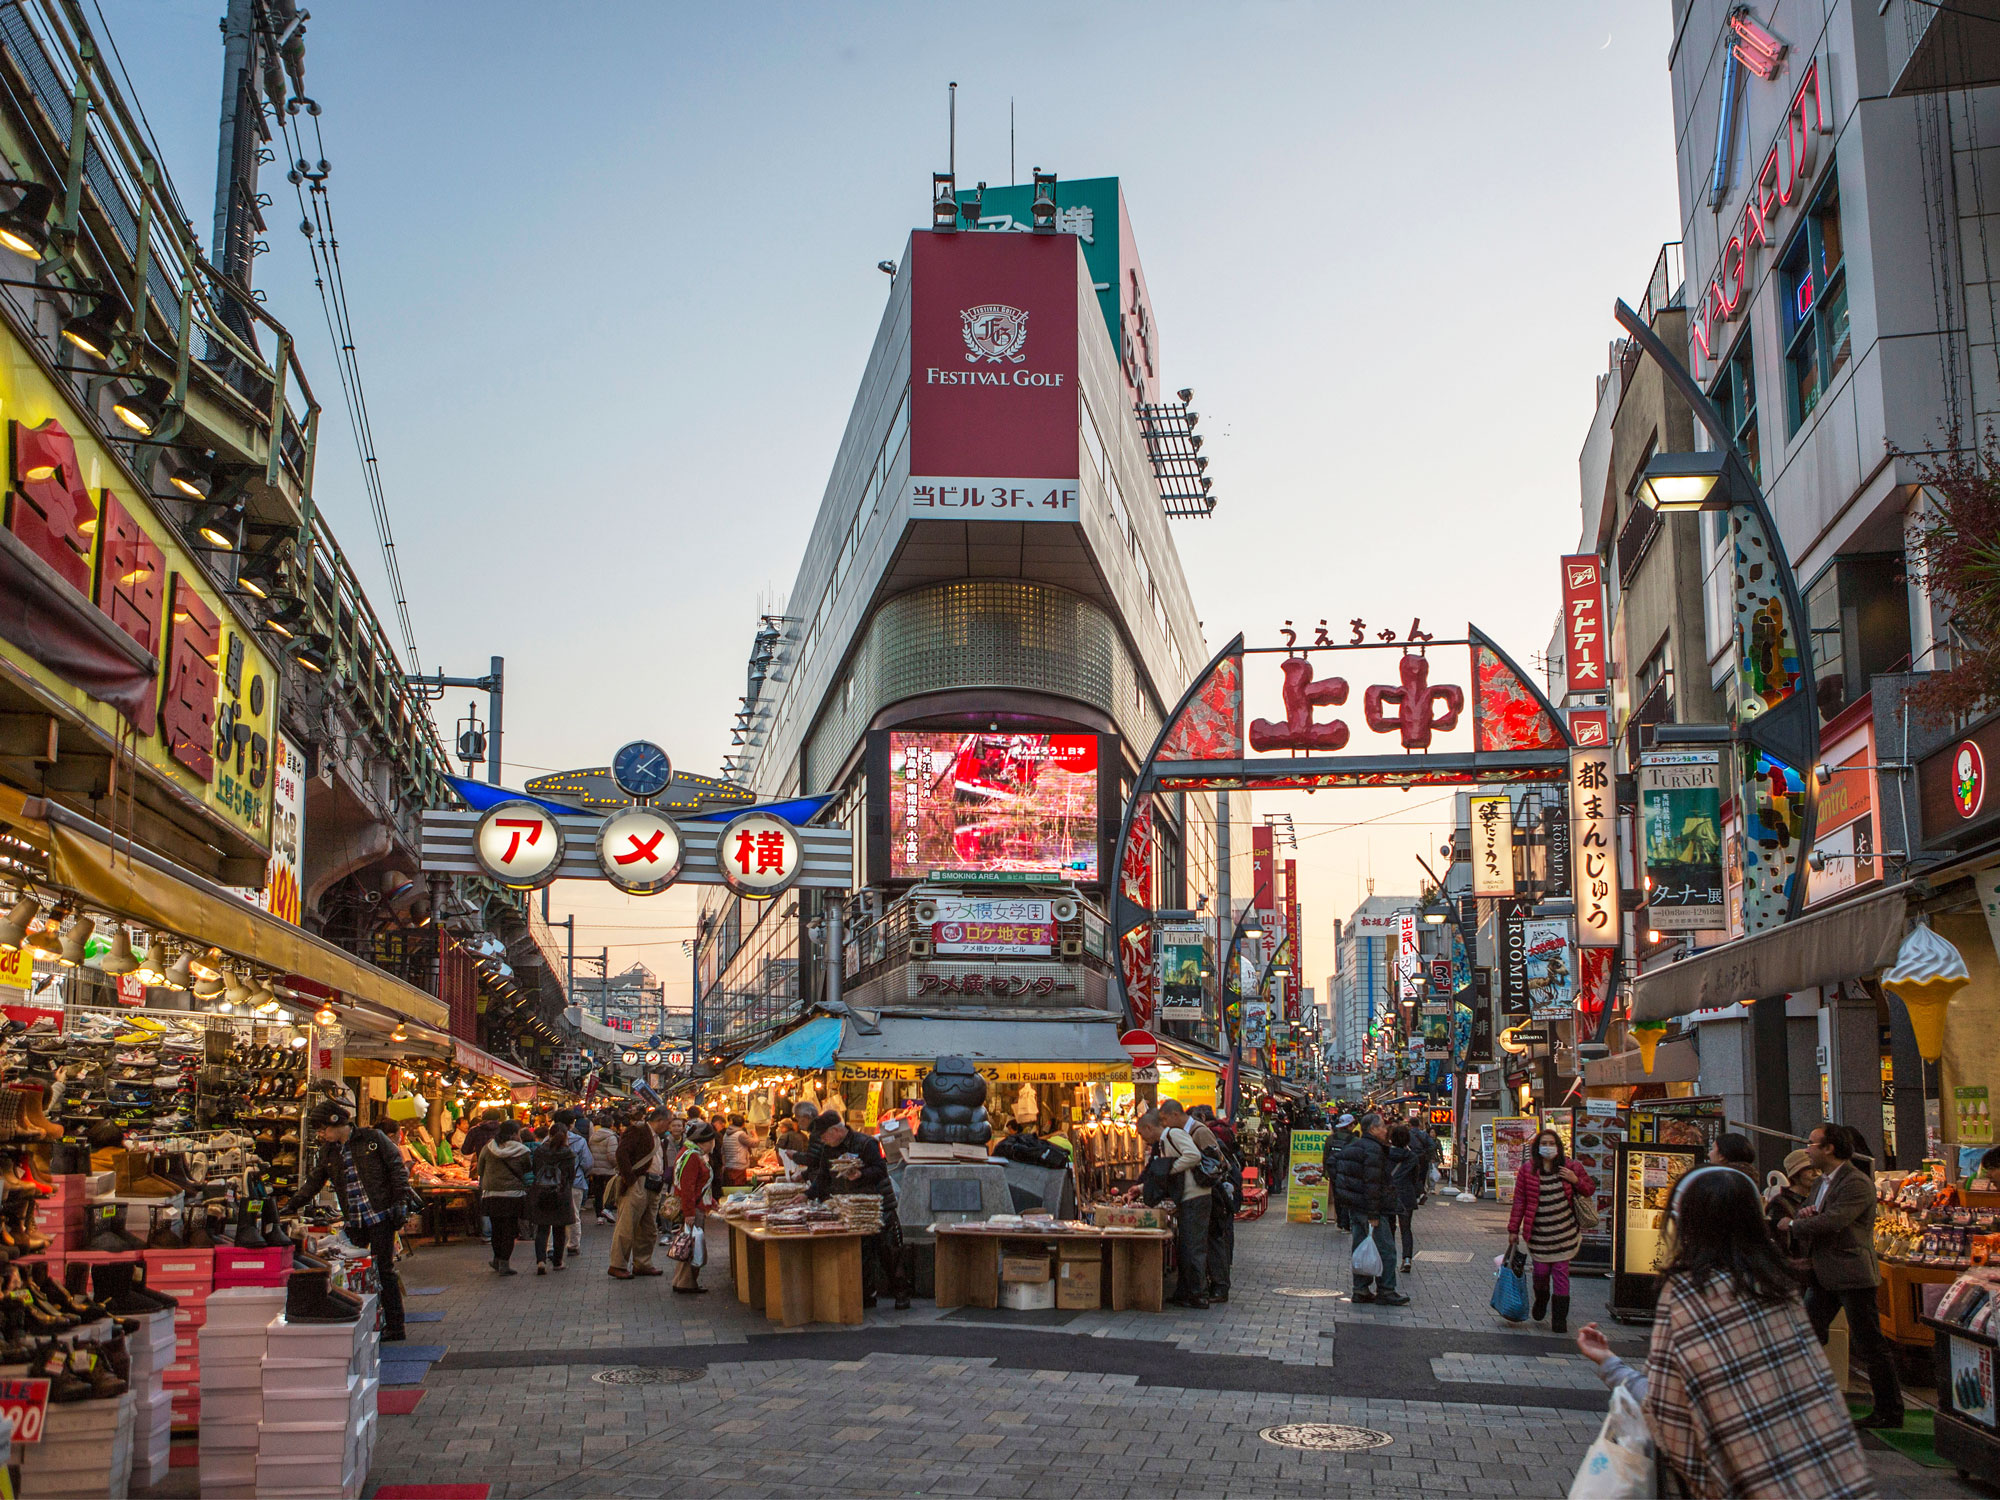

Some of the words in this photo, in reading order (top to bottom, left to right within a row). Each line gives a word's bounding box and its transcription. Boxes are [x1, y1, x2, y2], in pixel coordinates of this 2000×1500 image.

[926, 367, 1010, 387] FESTIVAL
[1013, 369, 1064, 387] GOLF
[1280, 617, 1433, 648] うえちゅん
[1572, 599, 1599, 679] アドアーズ
[1249, 654, 1464, 752] 上中
[1649, 767, 1714, 788] TURNER
[1817, 786, 1849, 826] antra
[495, 818, 786, 876] アメ横
[1552, 823, 1564, 886] ROOMPIA
[1577, 761, 1609, 930] 都まんじゅう
[941, 872, 978, 880] SMOKING
[979, 873, 1000, 881] AREA
[1651, 884, 1723, 906] ターナー展
[945, 903, 1044, 920] アメ横女学園
[966, 926, 1044, 941] ロケ地です
[961, 945, 1027, 953] アメ横センタービル
[1508, 923, 1524, 1010] ROOMPIA
[917, 974, 1076, 996] アメ横センター
[1164, 995, 1200, 1007] ターナー展
[841, 1066, 908, 1080] たらばがに
[1006, 1071, 1056, 1083] (株)石山商店
[1293, 1133, 1329, 1143] JUMBO
[0, 1405, 40, 1439] 90
